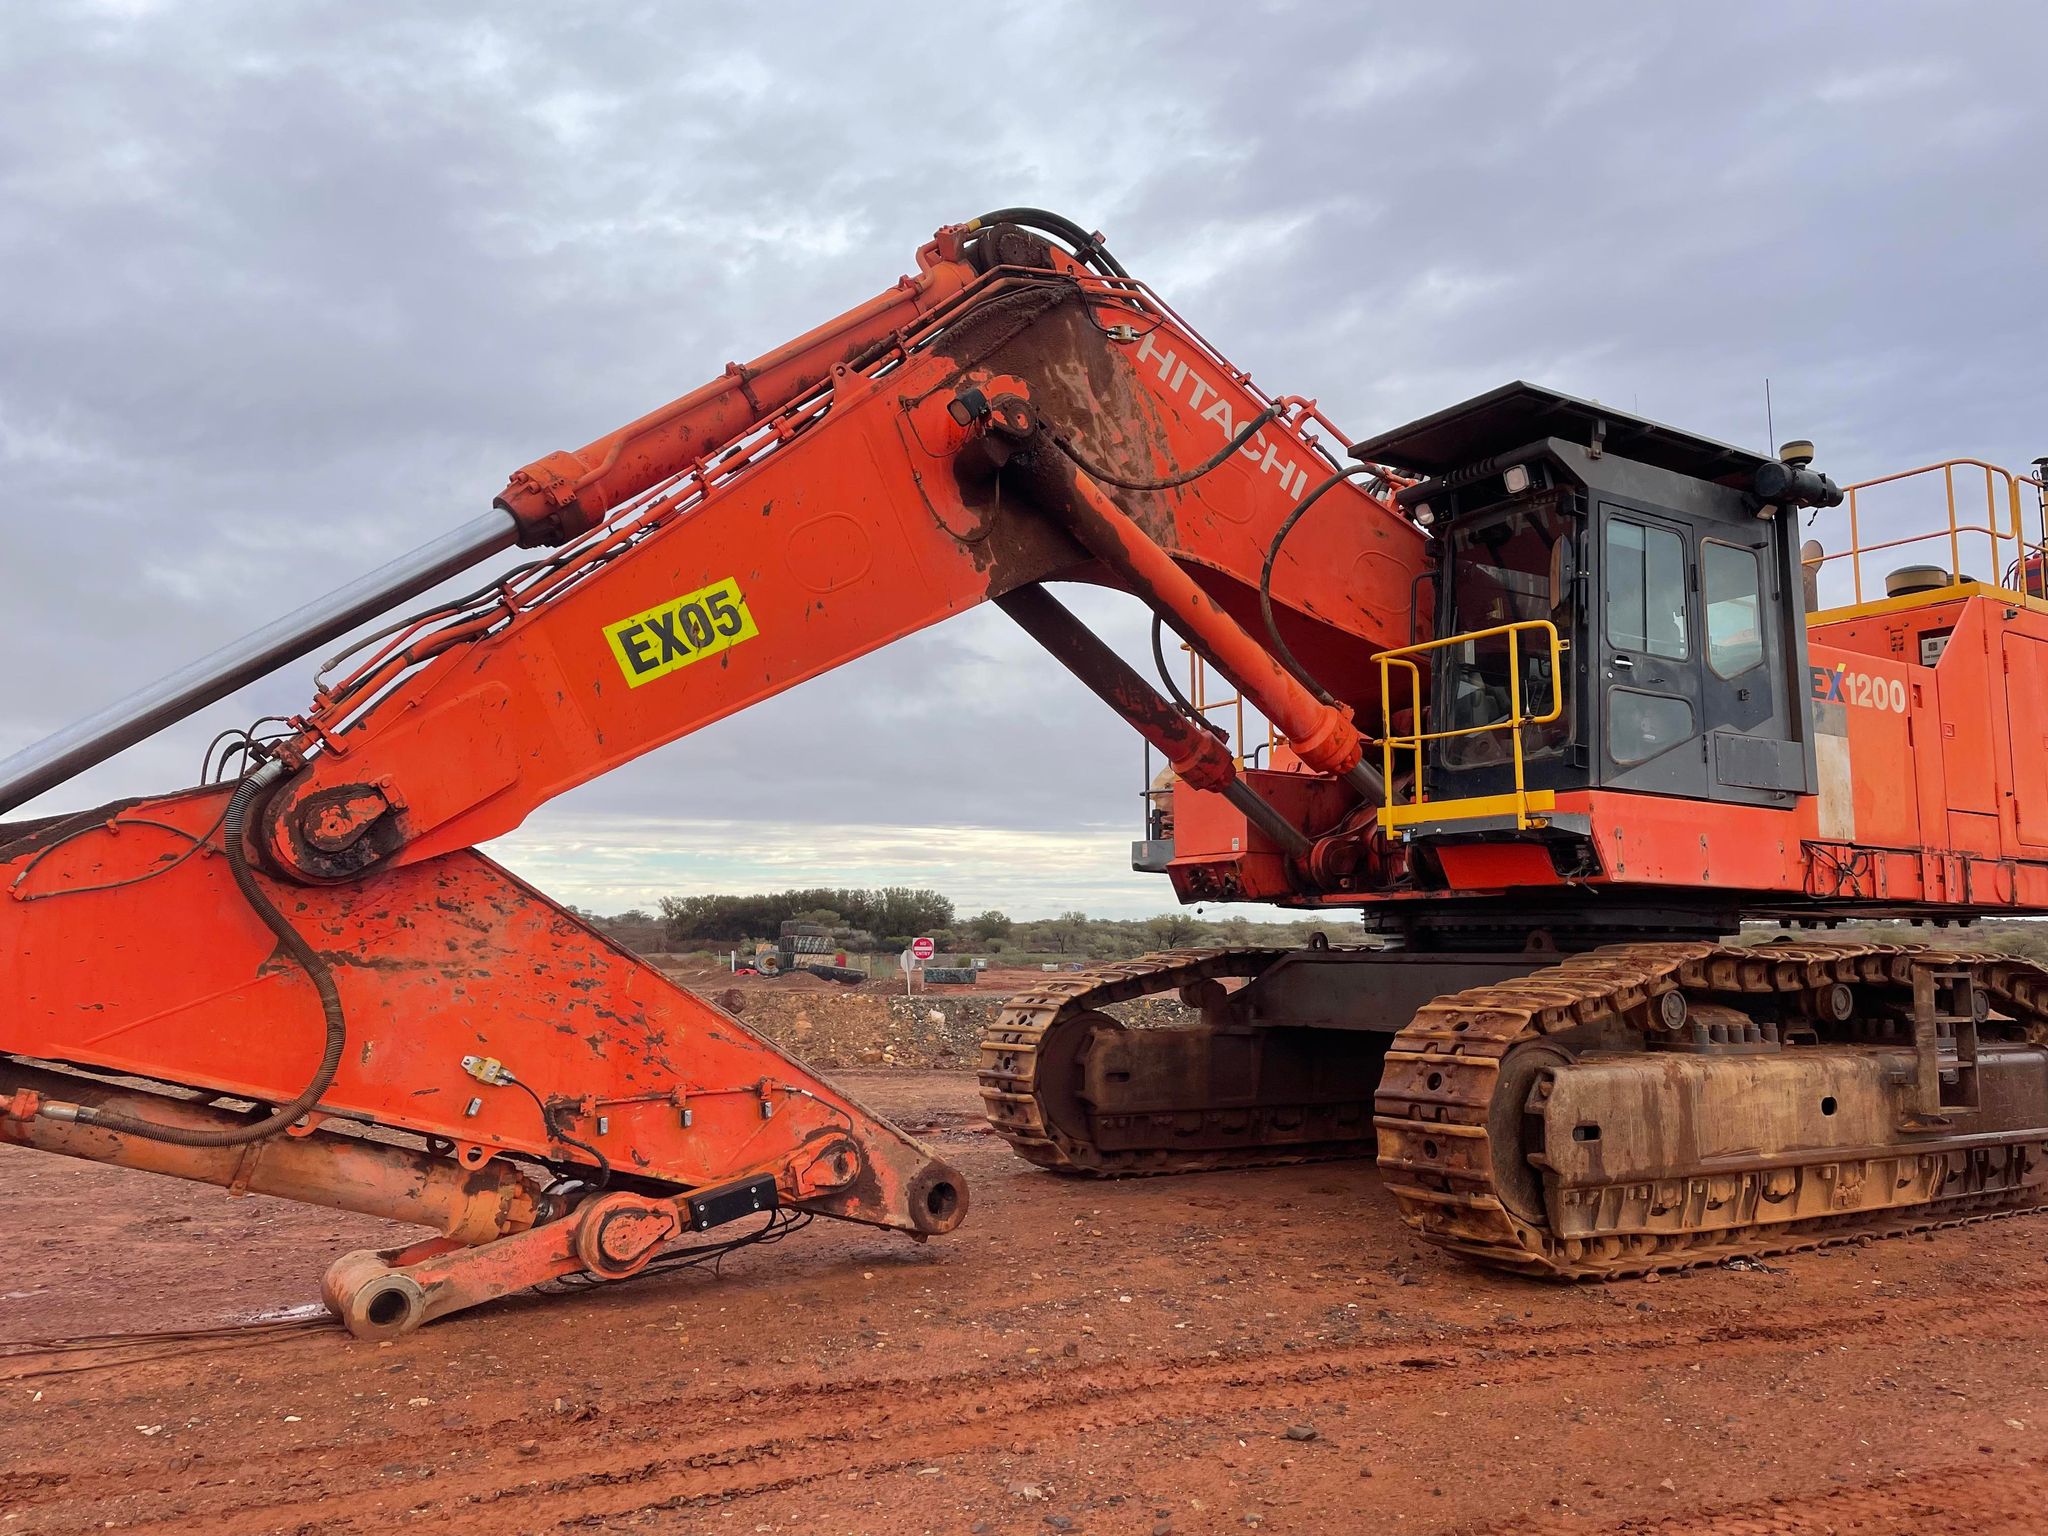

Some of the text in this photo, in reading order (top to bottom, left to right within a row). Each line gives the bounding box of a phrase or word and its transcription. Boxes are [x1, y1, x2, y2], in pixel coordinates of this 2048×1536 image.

[1136, 332, 1308, 501] HITACHI
[617, 590, 742, 675] EX05
[1810, 663, 1905, 713] EX1200
